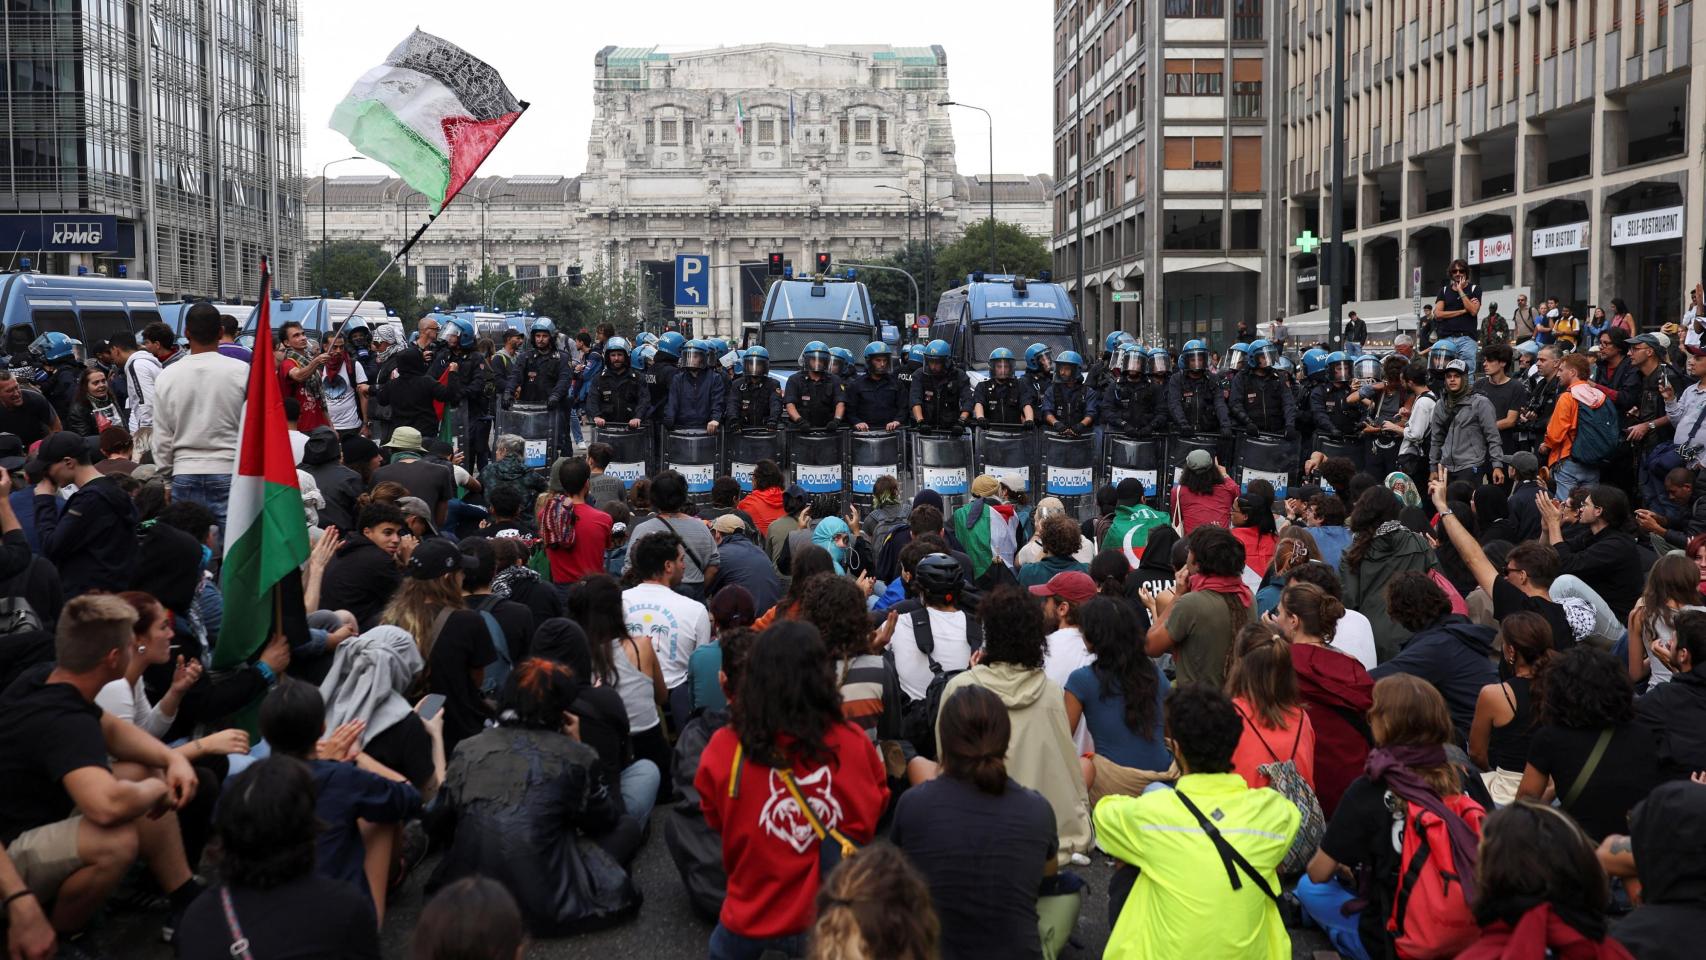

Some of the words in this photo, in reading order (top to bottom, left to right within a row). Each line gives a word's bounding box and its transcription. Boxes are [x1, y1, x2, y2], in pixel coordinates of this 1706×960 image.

[1628, 213, 1678, 237] SELF-RESTAURANT
[52, 229, 102, 244] KPMG
[1545, 233, 1554, 248] BAR
[1556, 230, 1576, 247] BISTROT
[1484, 240, 1511, 257] GIMOKA
[683, 257, 702, 282] P
[986, 301, 1057, 310] POLIZIA
[684, 473, 709, 485] LIZIA
[802, 474, 837, 485] POLIZIA
[930, 476, 962, 487] POLIZIA
[1052, 476, 1088, 487] POLIZIA
[1143, 580, 1176, 598] CHA
